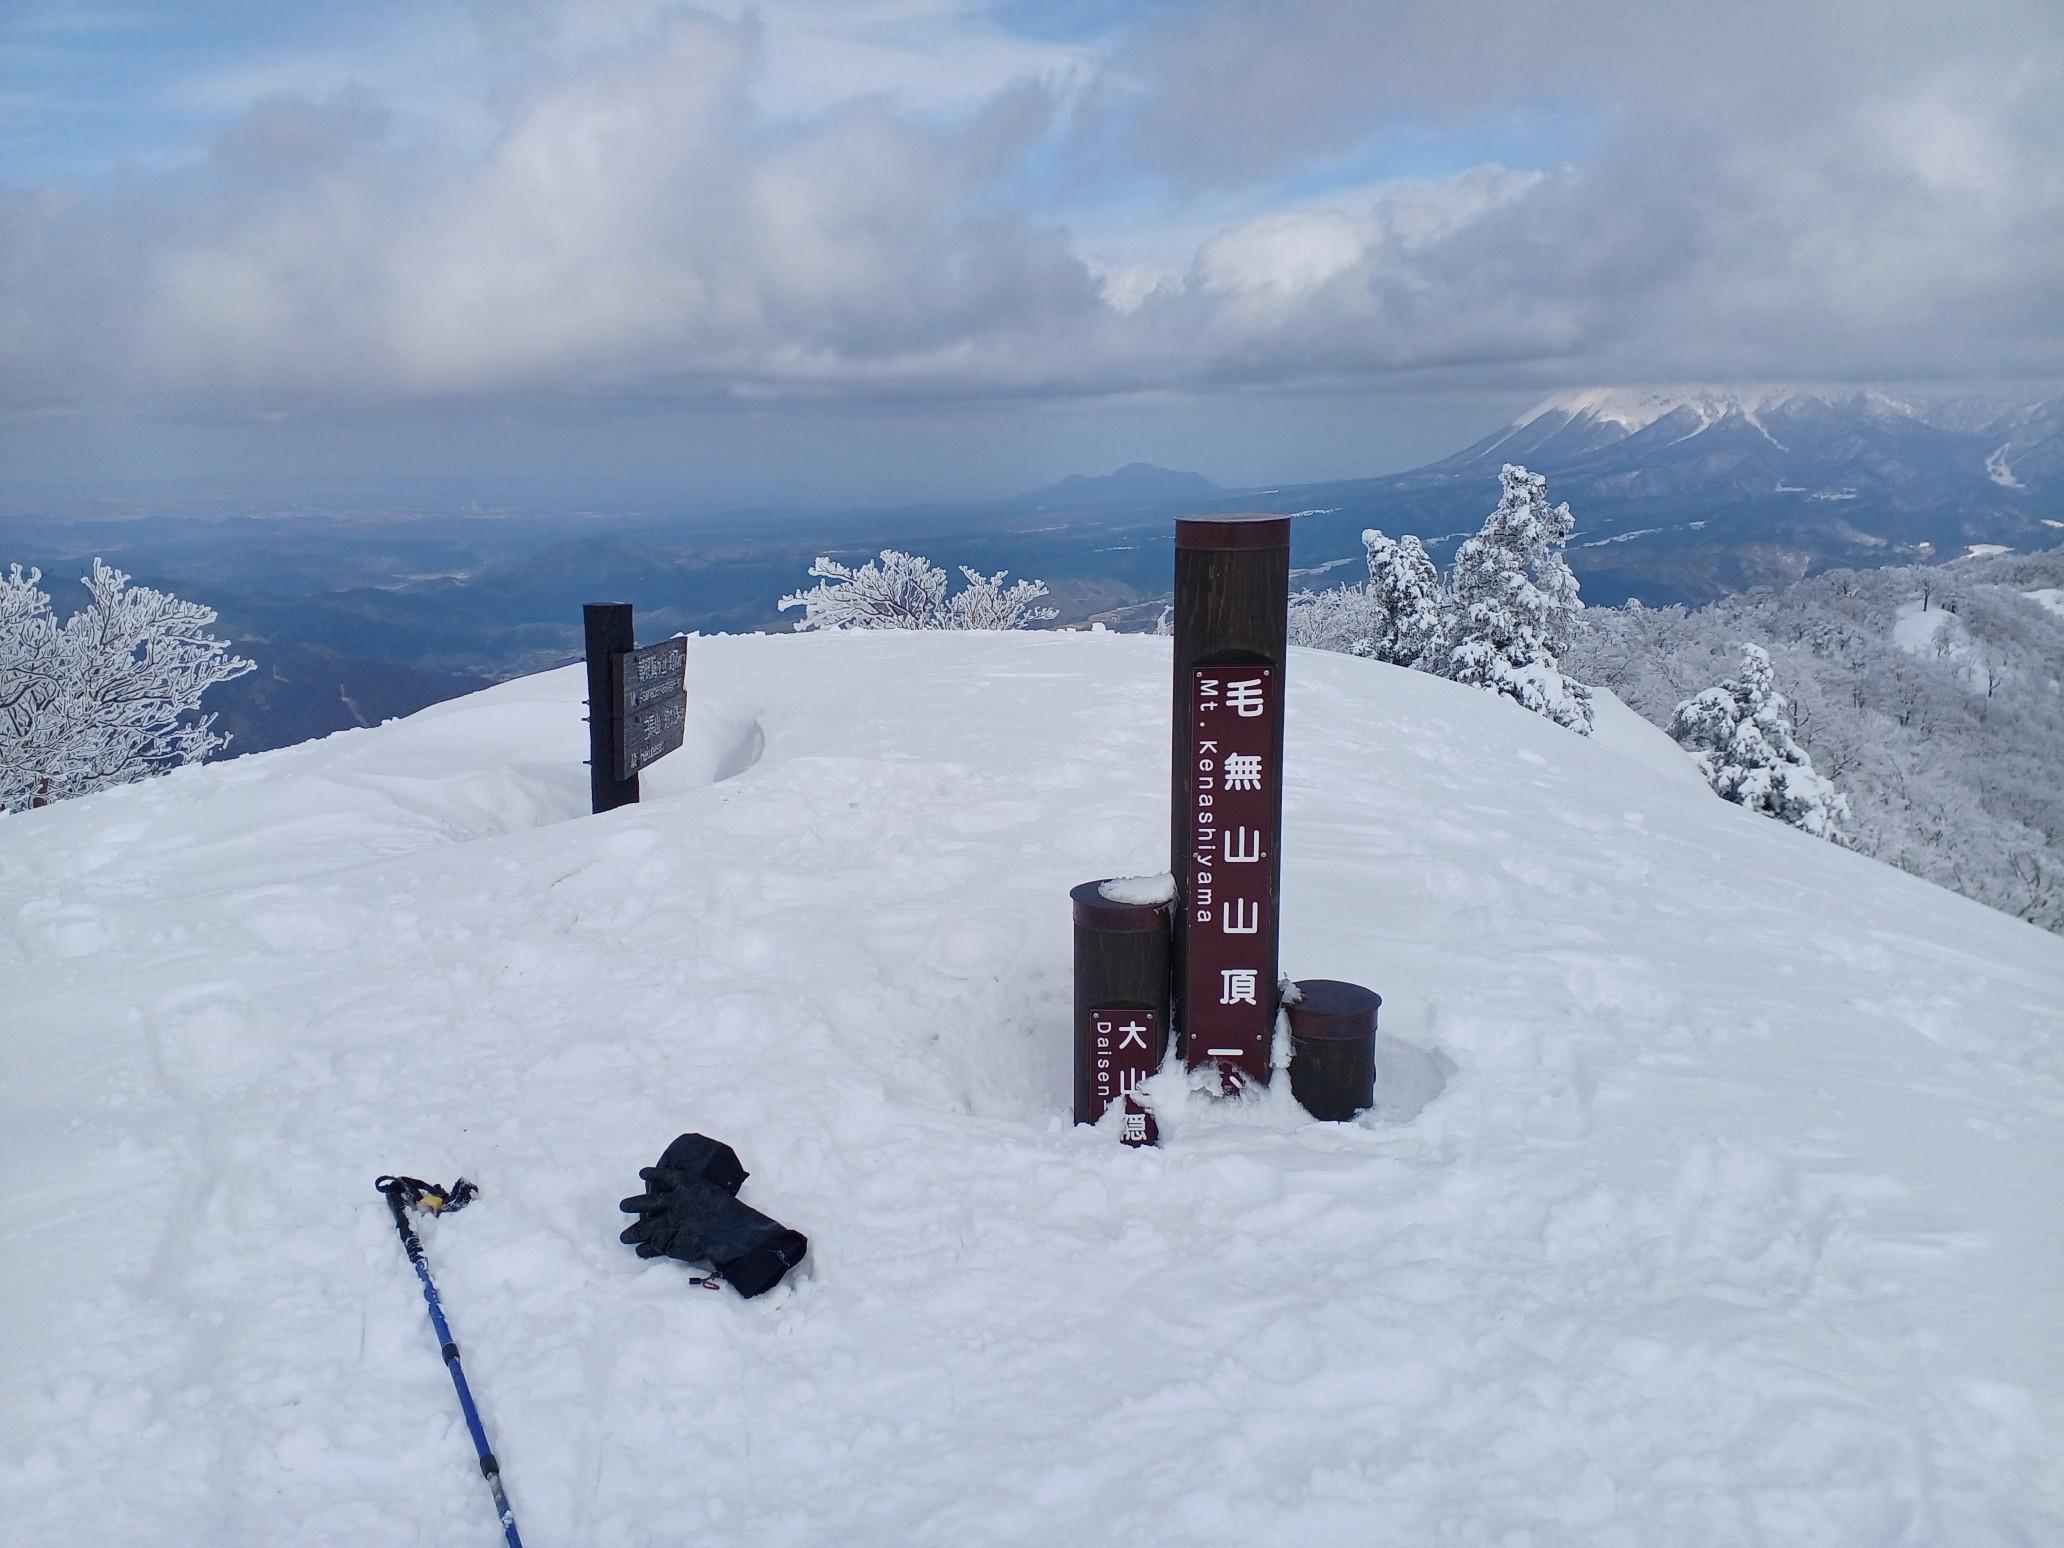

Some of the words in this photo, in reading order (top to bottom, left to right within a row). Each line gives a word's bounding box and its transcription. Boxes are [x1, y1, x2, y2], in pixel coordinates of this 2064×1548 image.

[1199, 679, 1219, 728] Mt.
[1196, 740, 1218, 923] Kenashiyama
[1219, 678, 1264, 1006] 毛無山山頂
